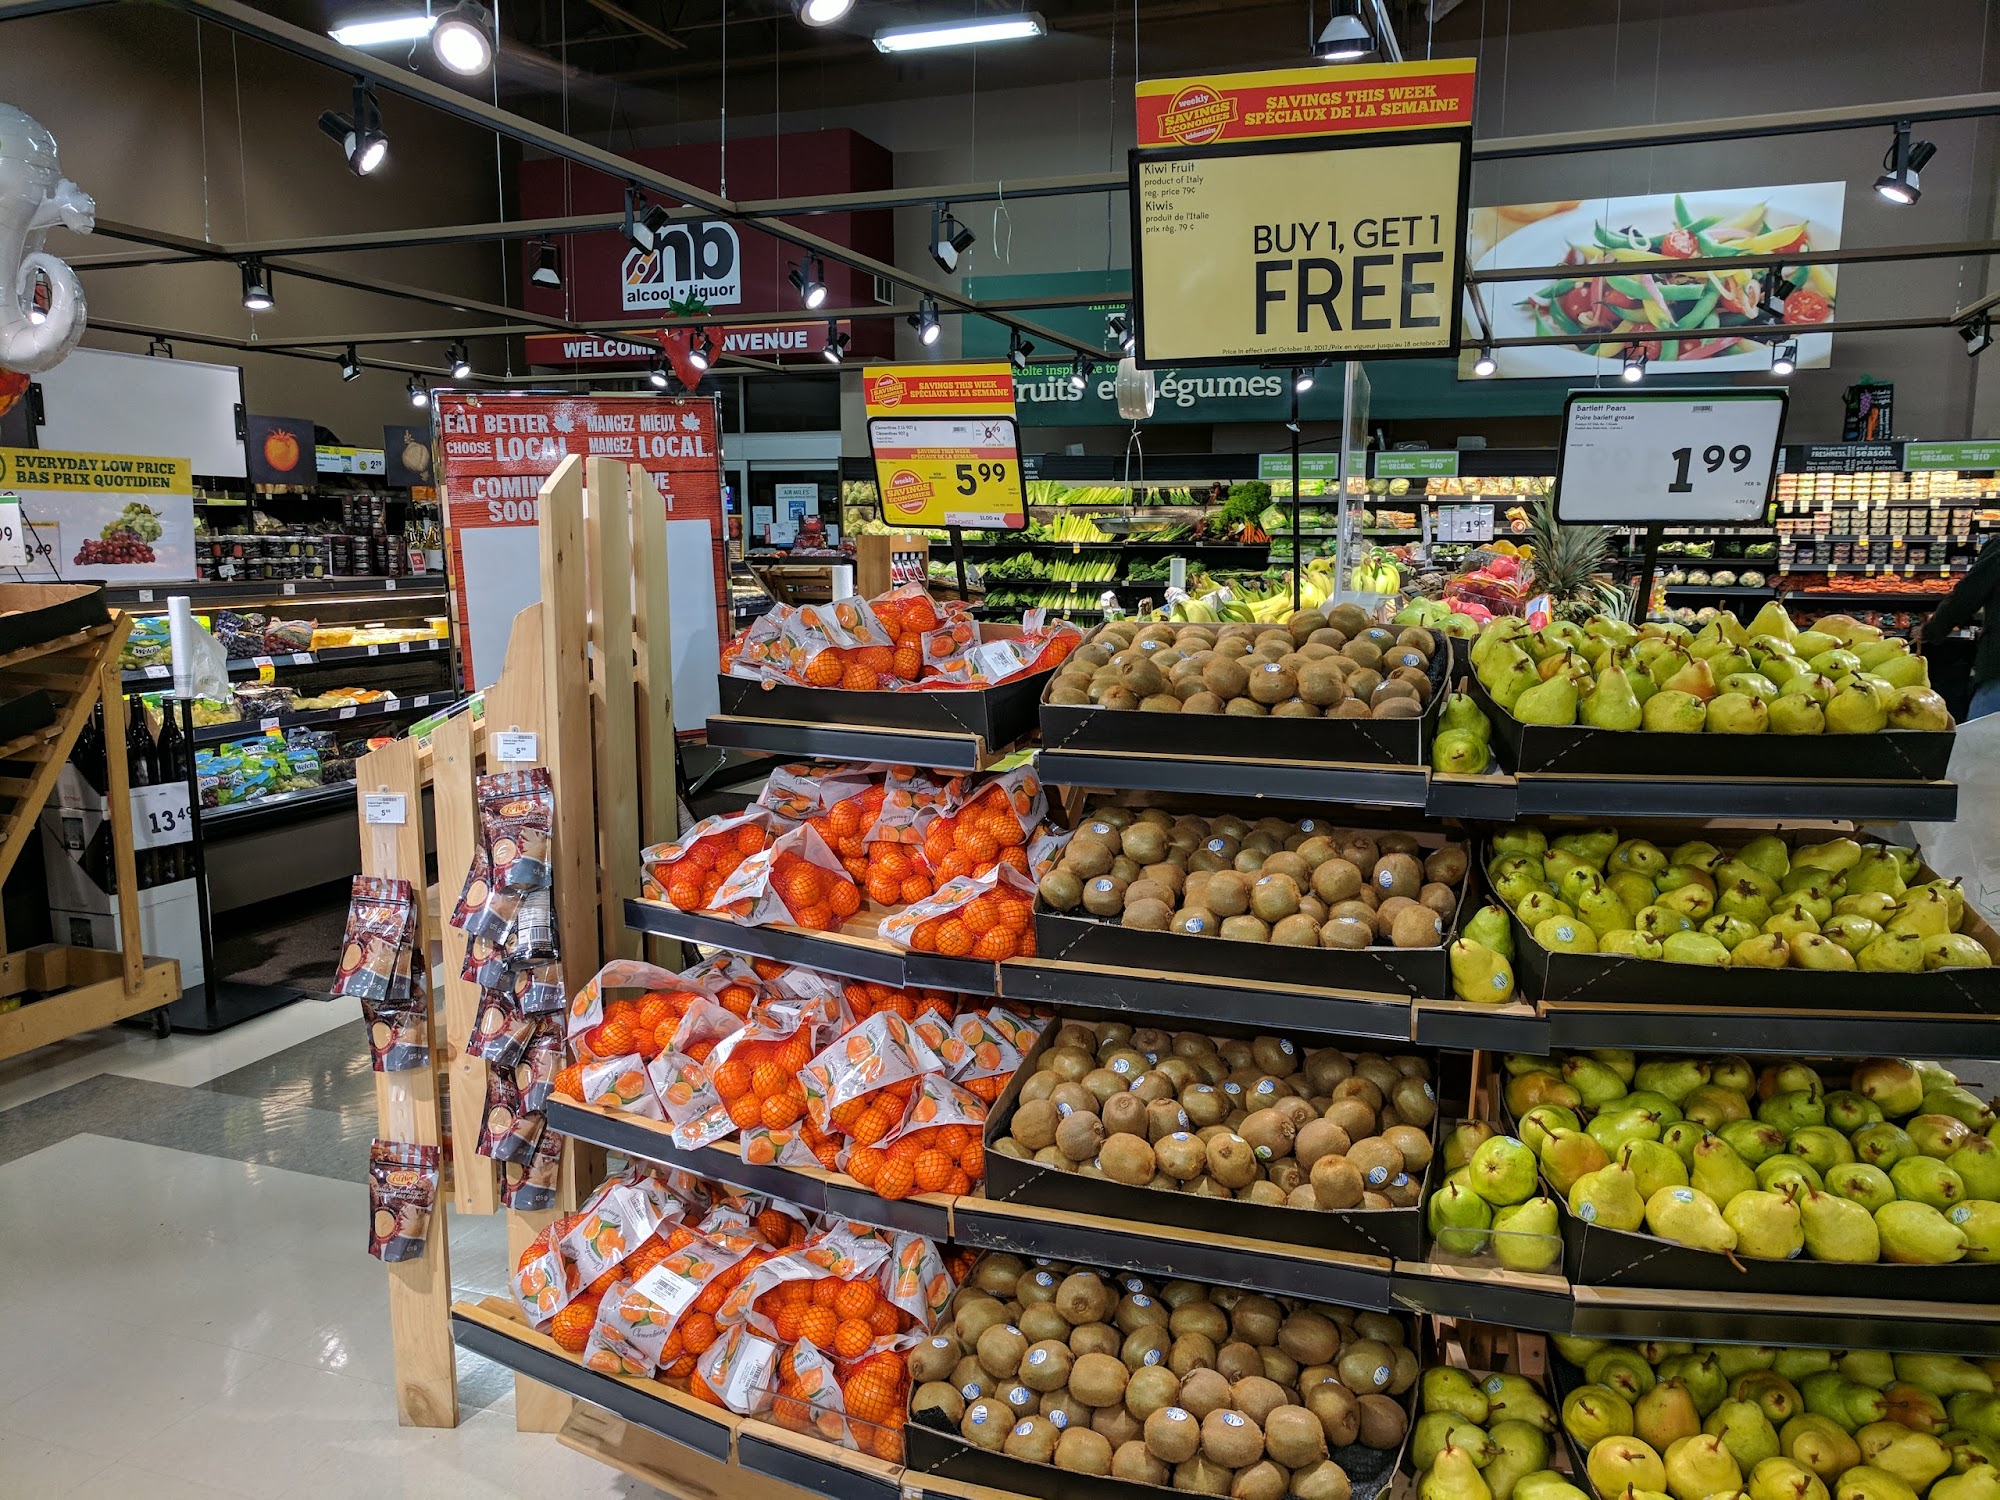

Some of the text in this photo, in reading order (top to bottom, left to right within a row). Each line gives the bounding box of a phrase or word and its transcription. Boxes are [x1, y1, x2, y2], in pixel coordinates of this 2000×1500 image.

[1179, 94, 1209, 107] weekly
[1266, 85, 1437, 109] SAVINGS THIS WEEK
[1164, 101, 1230, 126] SAVINGS
[1244, 98, 1459, 125] SPÉCIAUX DE LA SEMAINE
[1165, 112, 1230, 134] ÉCONOMIES
[1144, 162, 1195, 174] Kiwi Fruit
[1144, 175, 1204, 187] product of Italy
[1144, 190, 1159, 199] reg.
[1161, 188, 1180, 198] price
[1145, 201, 1174, 211] Kiwis
[1145, 212, 1210, 224] produit de l'Italie
[1145, 225, 1160, 235] prix
[1162, 224, 1177, 234] rég.
[1179, 223, 1188, 231] 79
[1254, 220, 1320, 255] BUY
[1353, 215, 1423, 249] GET
[1430, 214, 1440, 245] 1
[626, 285, 736, 303] alcool liquor
[1255, 251, 1444, 335] FREE
[721, 331, 808, 352] NVENUE
[1245, 346, 1263, 354] effect
[1278, 345, 1302, 353] October
[1011, 364, 1043, 377] écolte
[873, 383, 904, 396] SAVINGS
[919, 380, 998, 390] SAVINGS THIS WEEK
[910, 387, 1009, 398] SPÉCIAUX DE LA SEMAINE
[1576, 404, 1627, 412] Bartlett Pears
[443, 413, 549, 434] EAT BETTER
[587, 414, 677, 433] MANGEZ MIEUX
[446, 441, 491, 454] CHOOSE
[589, 435, 714, 459] MANGEZ LOCAL.
[1921, 453, 1990, 462] ORGANIC BIO
[15, 455, 176, 475] EVERYDAY LOW PRICE
[16, 470, 170, 488] BAS PRIX QUOTIDIEN
[894, 476, 915, 485] weekly
[472, 475, 546, 500] COMIN
[887, 483, 930, 498] SAVINGS
[296, 761, 318, 771] Welch's
